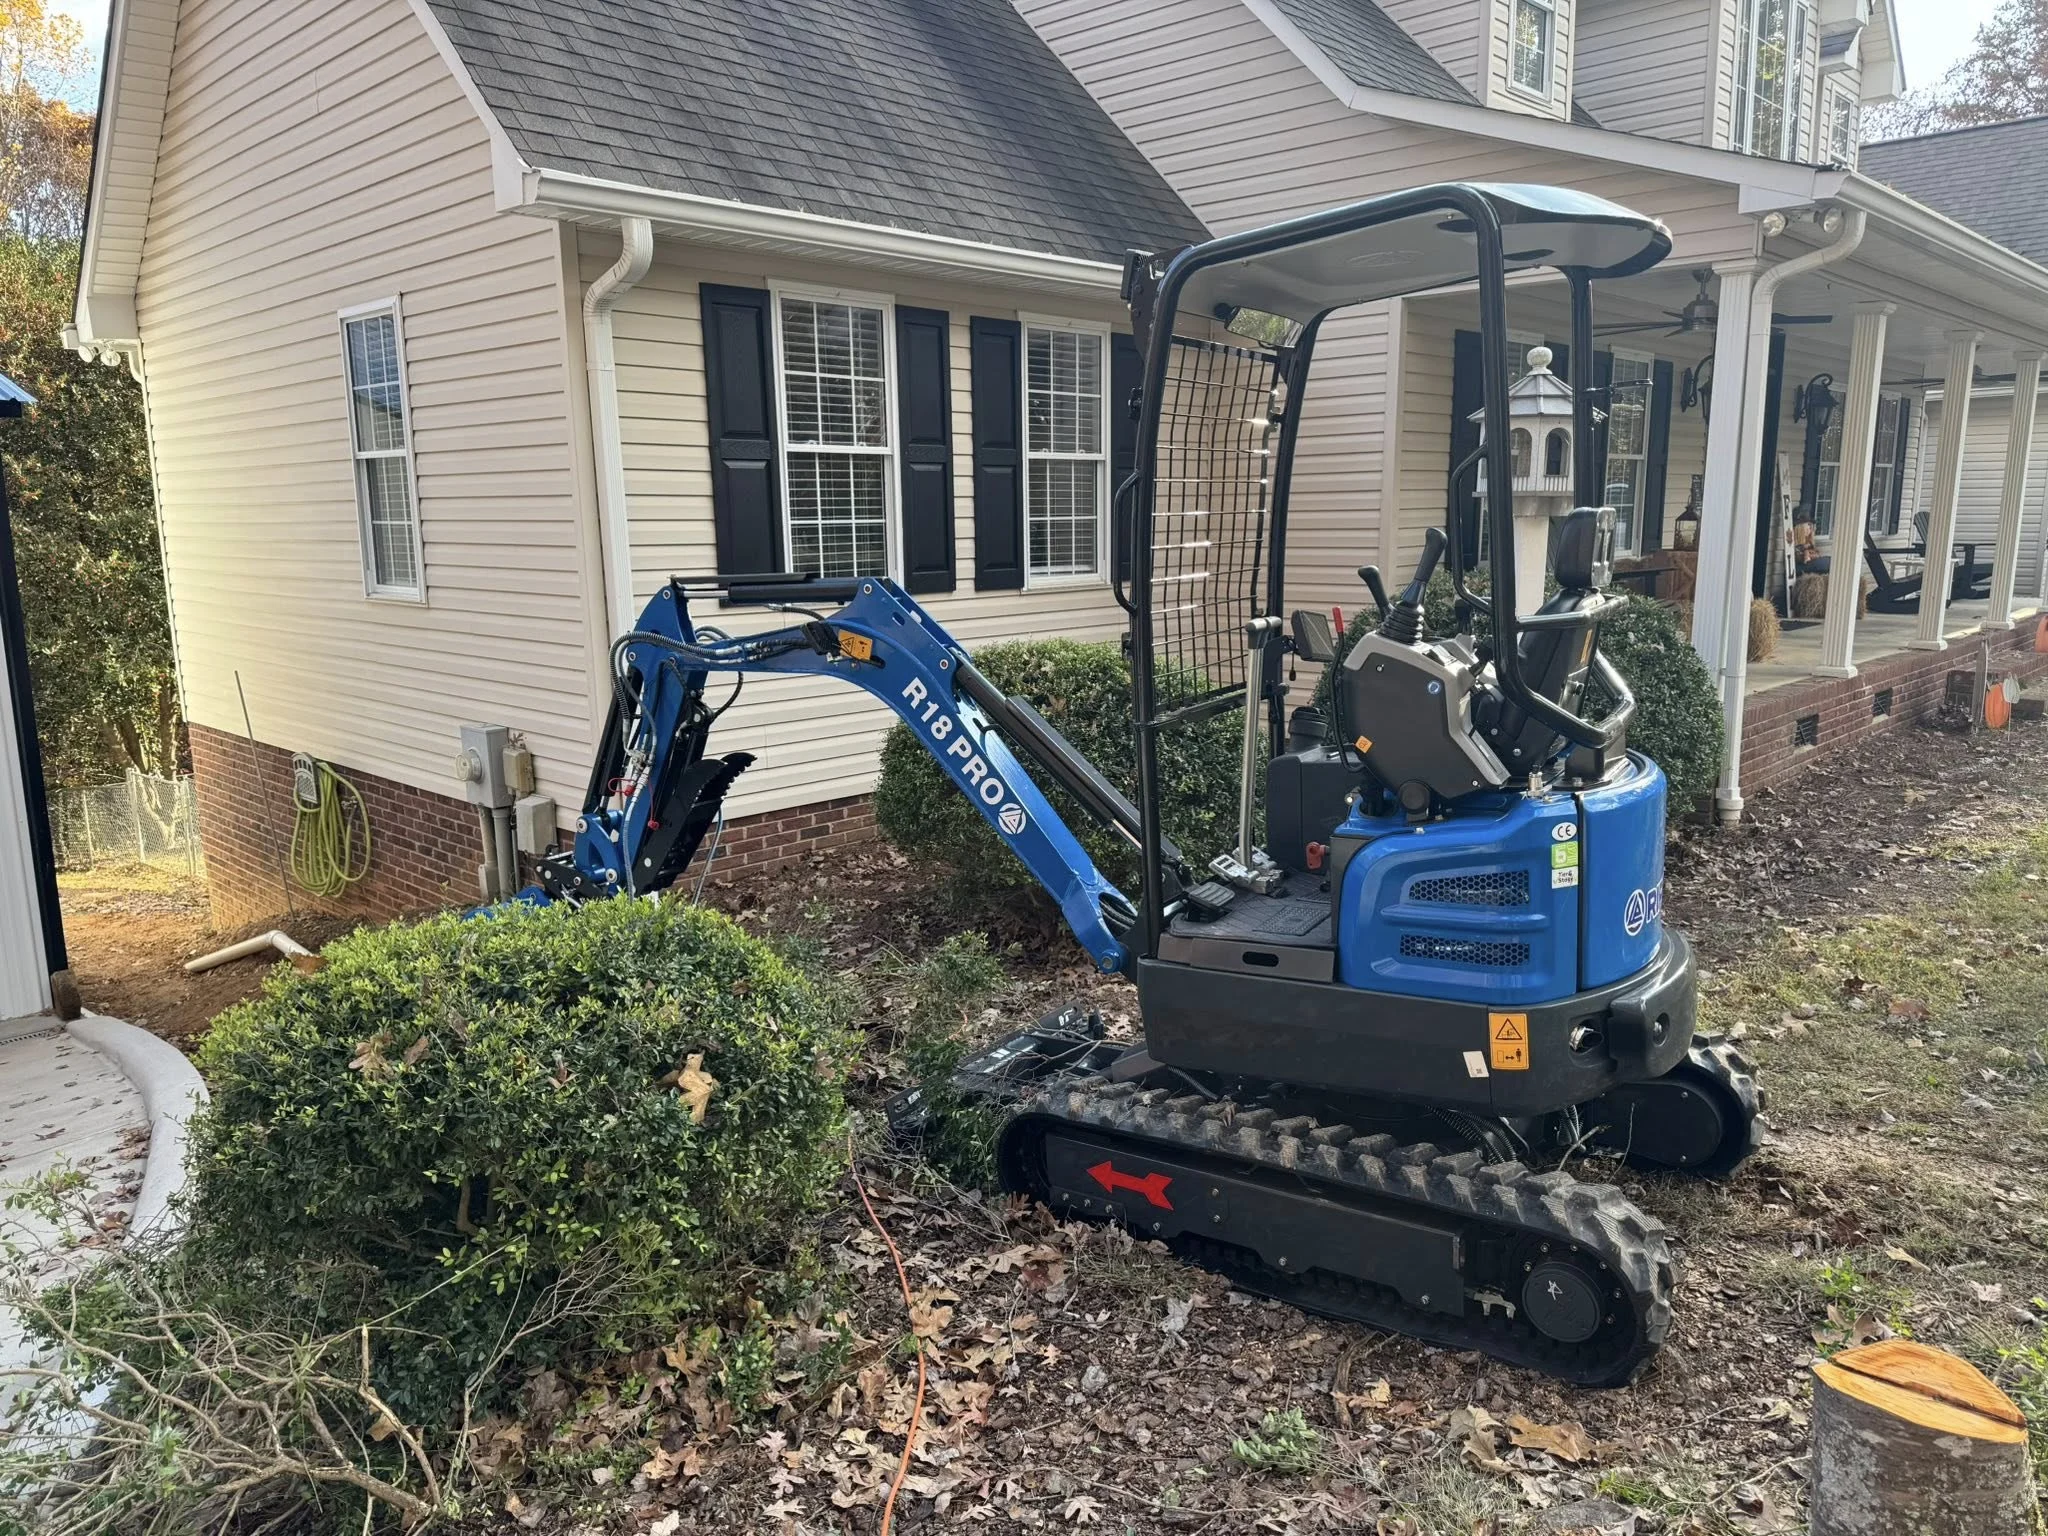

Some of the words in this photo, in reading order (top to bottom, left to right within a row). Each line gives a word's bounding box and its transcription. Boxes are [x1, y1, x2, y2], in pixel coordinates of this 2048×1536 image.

[902, 677, 952, 740] R18
[946, 735, 1005, 805] PRO
[1557, 825, 1571, 838] CE
